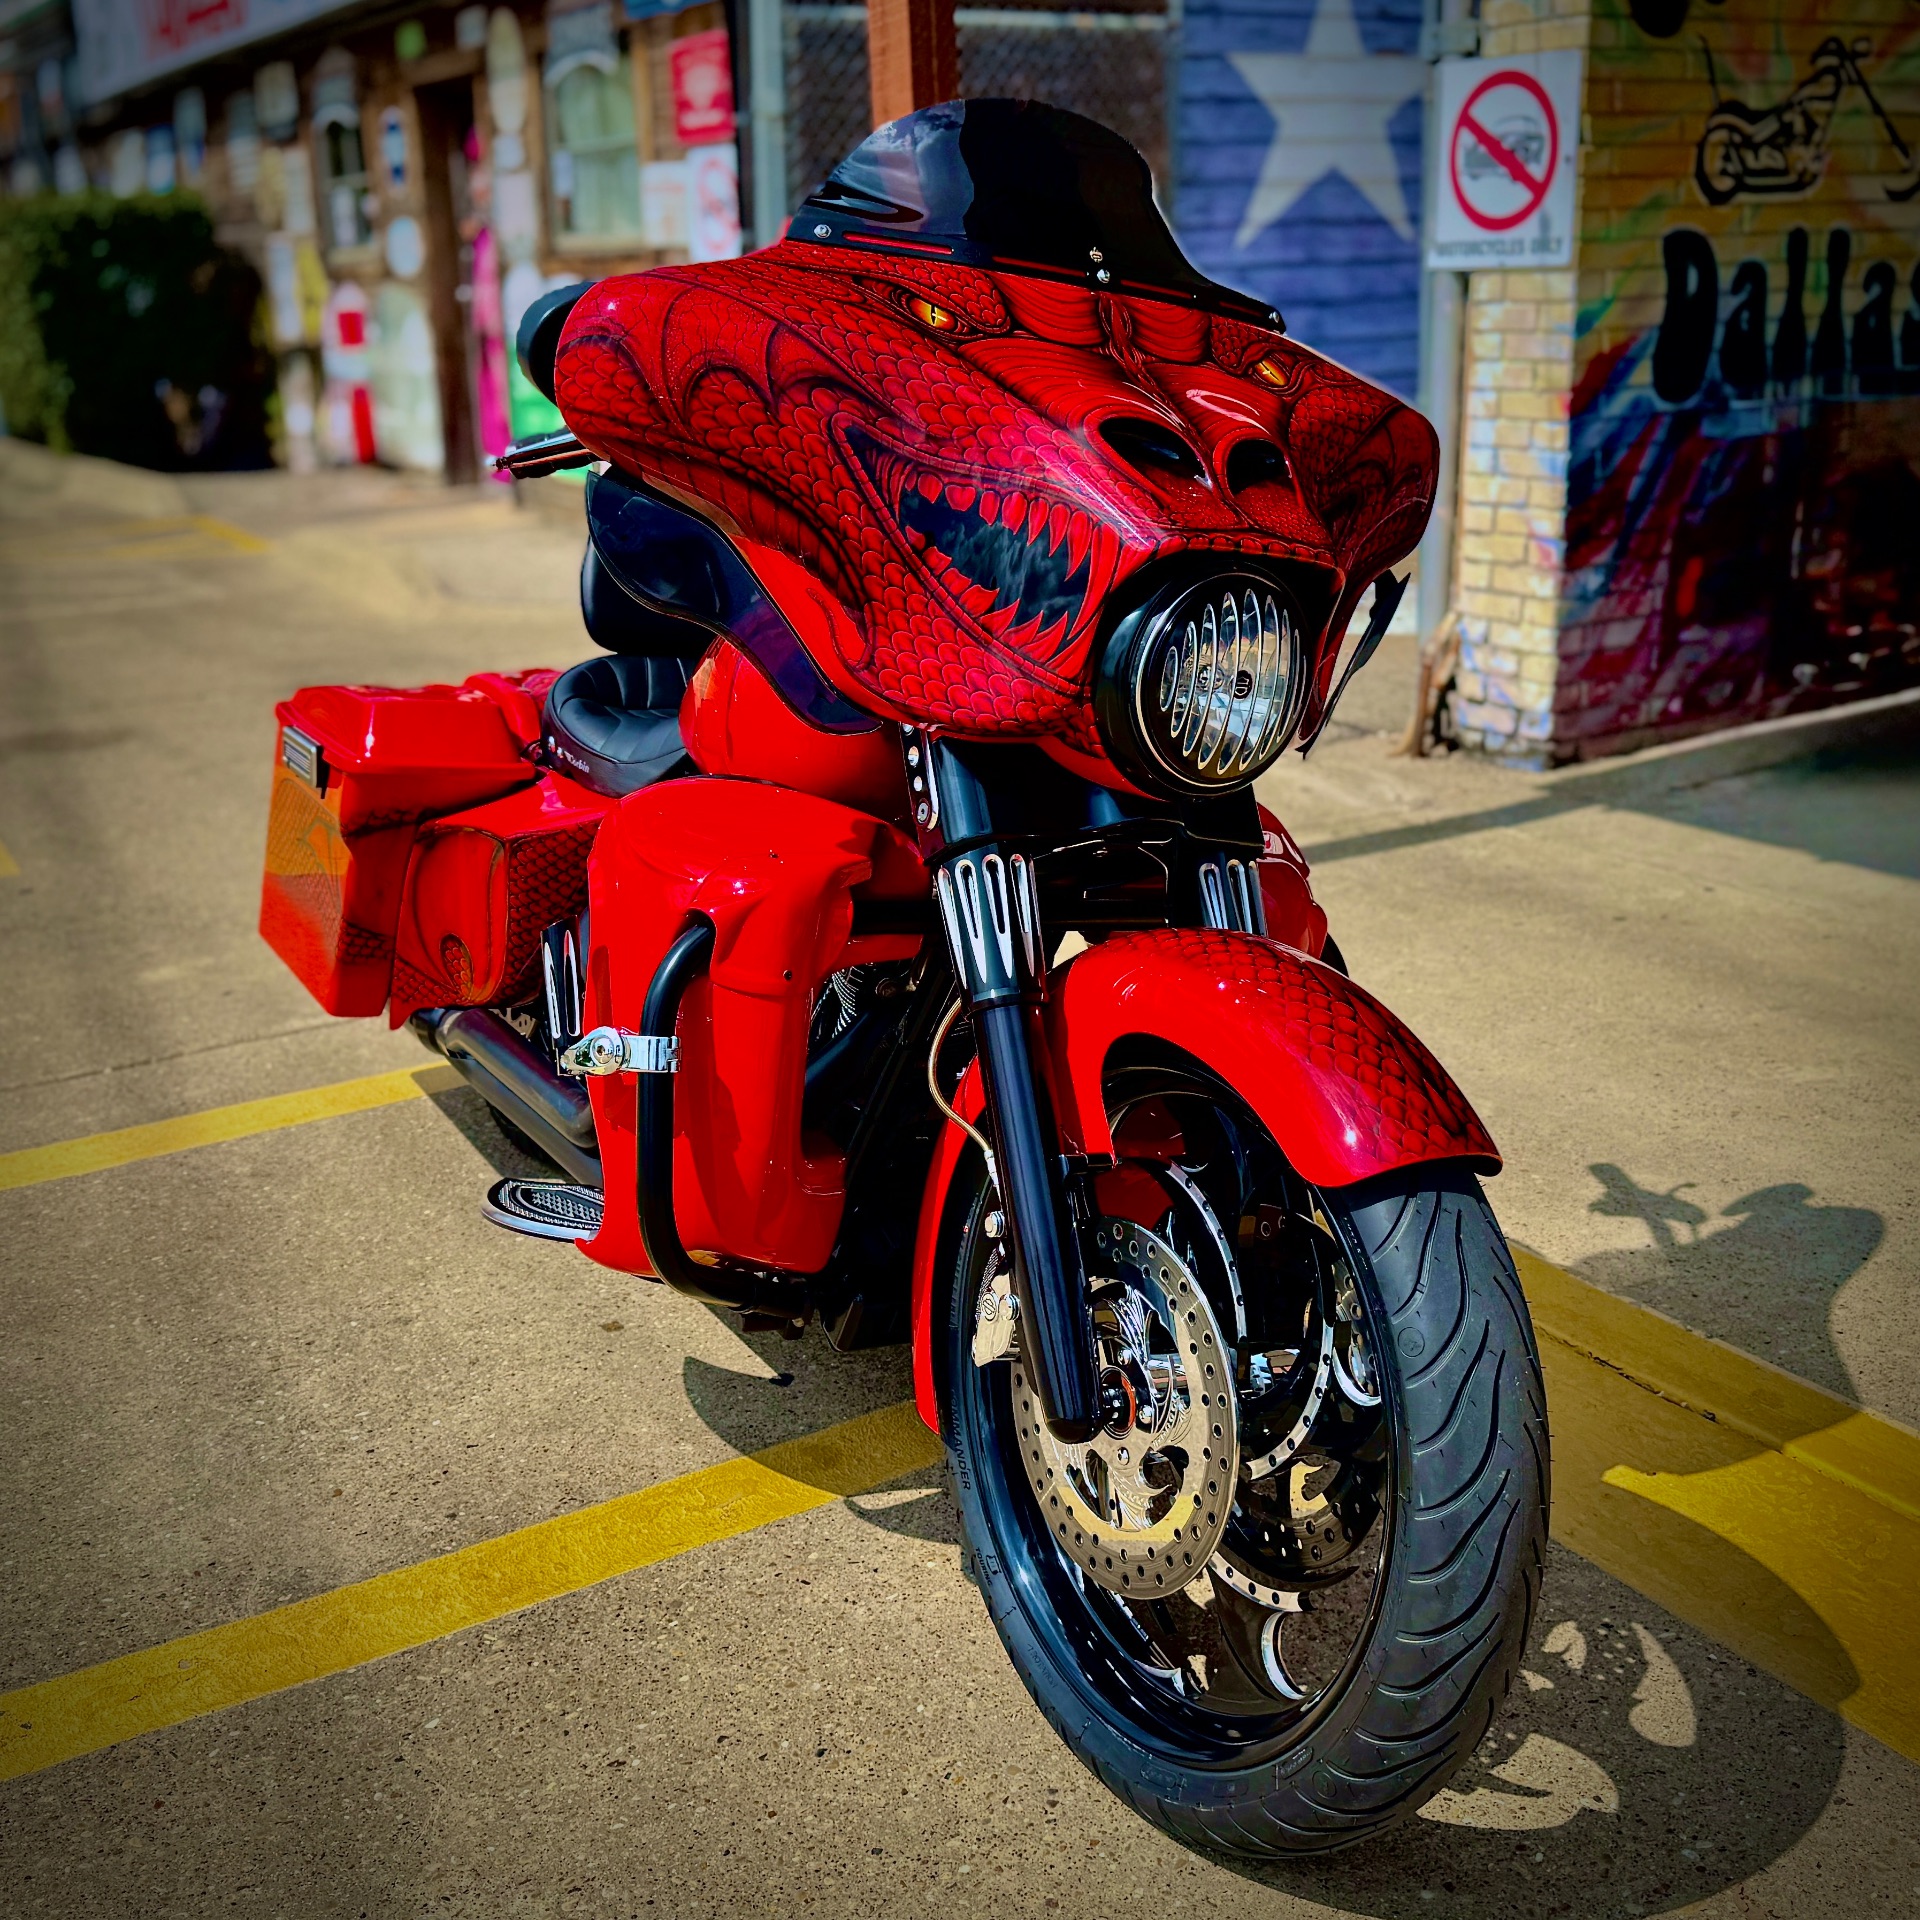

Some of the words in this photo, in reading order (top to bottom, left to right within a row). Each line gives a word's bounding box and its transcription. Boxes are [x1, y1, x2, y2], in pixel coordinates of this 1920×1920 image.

[1437, 239, 1525, 257] MOTORCYCLES
[1531, 237, 1562, 255] ONLY
[951, 1387, 972, 1491] COMMANDER
[975, 1546, 994, 1586] TOURING
